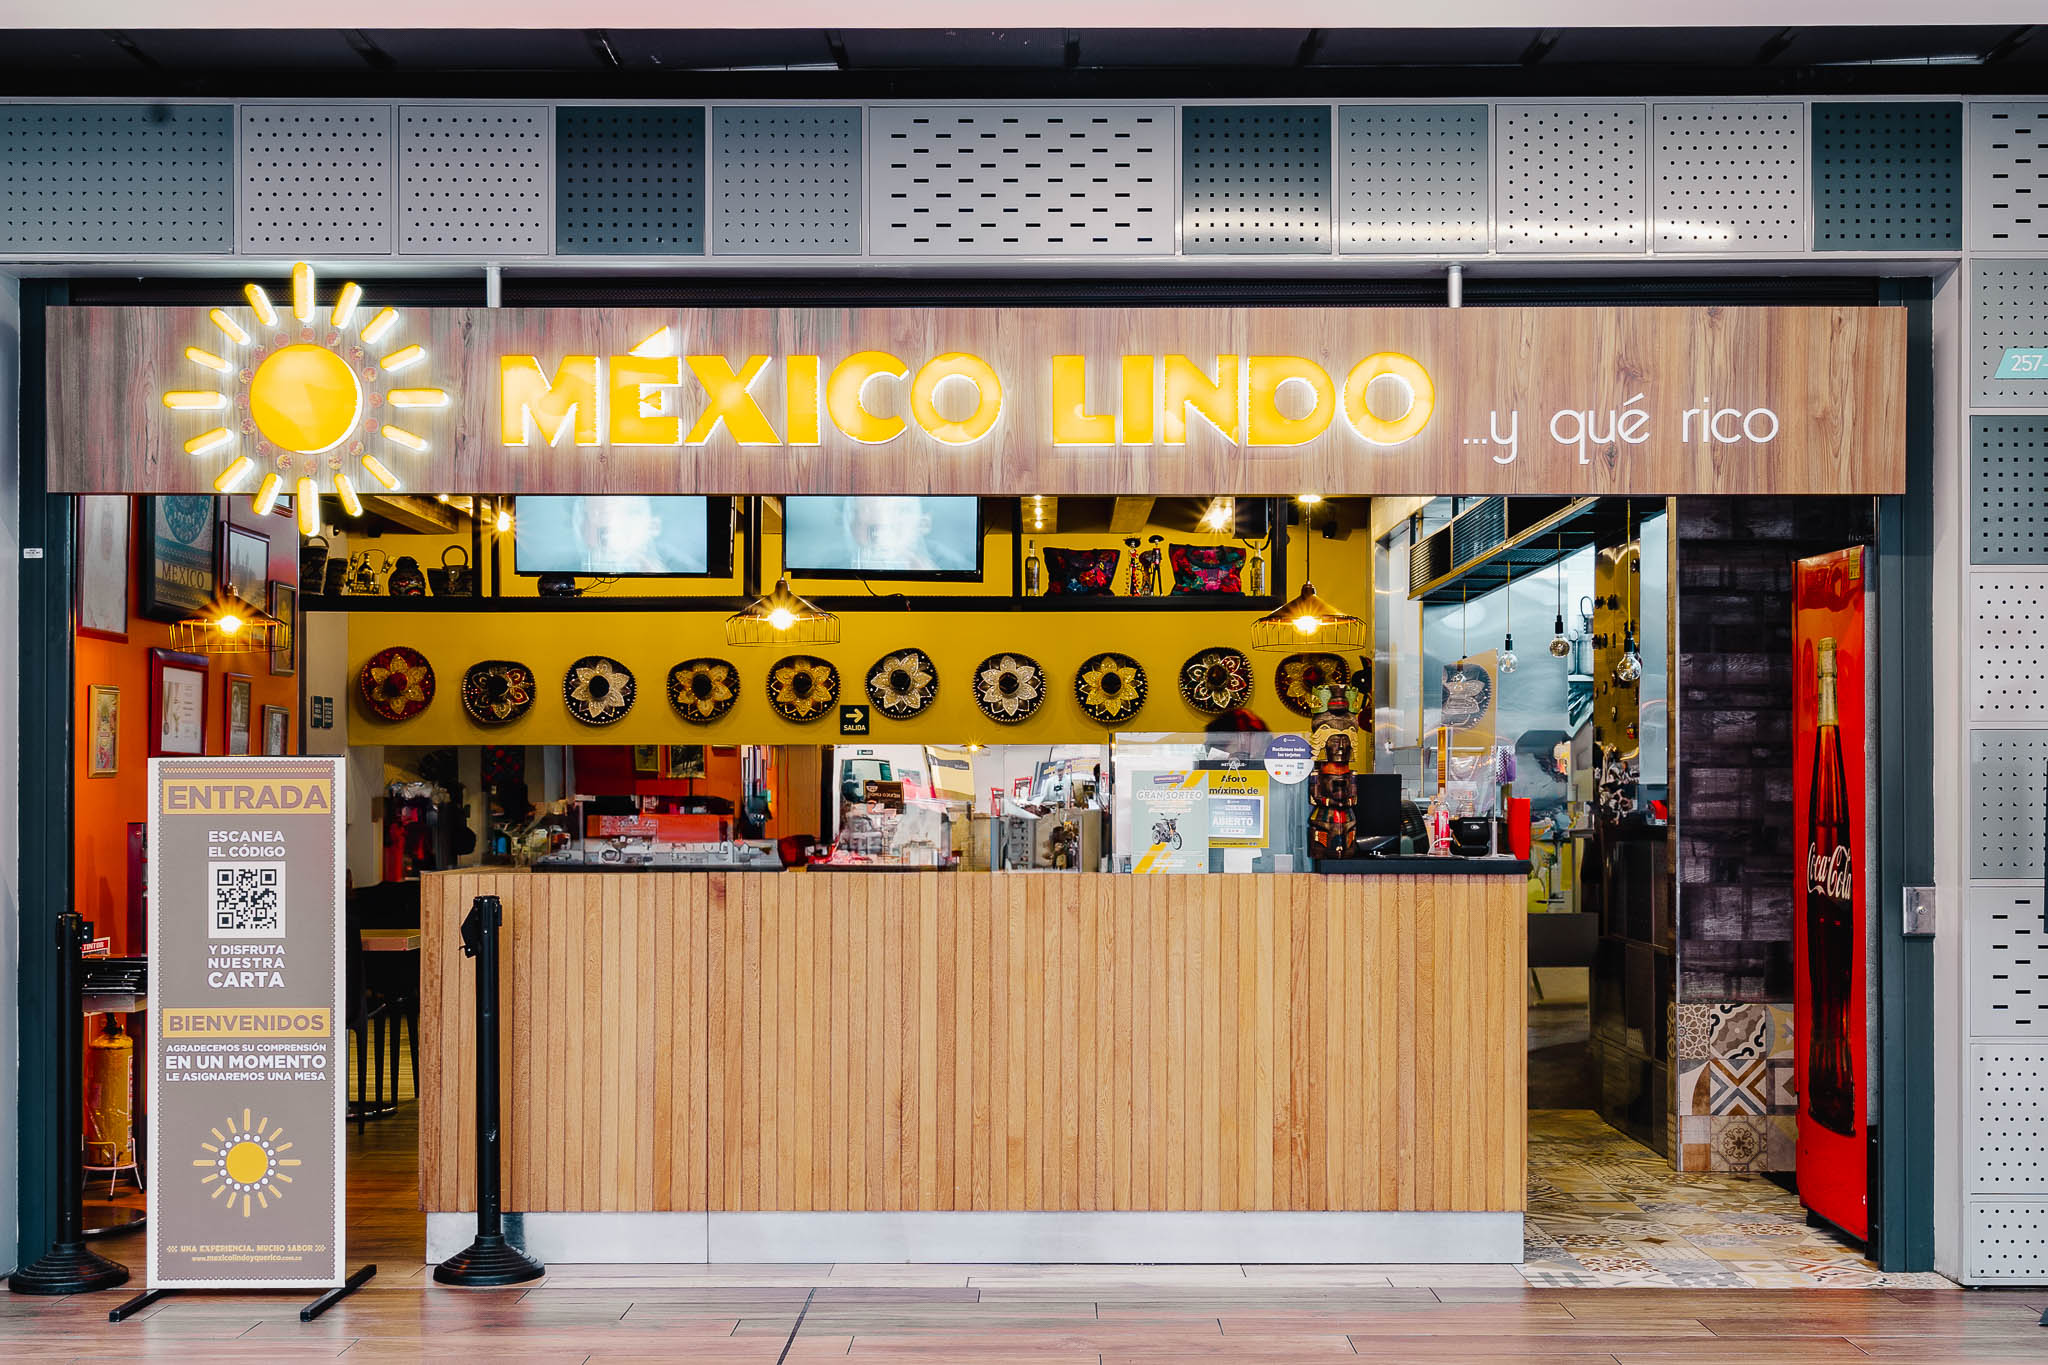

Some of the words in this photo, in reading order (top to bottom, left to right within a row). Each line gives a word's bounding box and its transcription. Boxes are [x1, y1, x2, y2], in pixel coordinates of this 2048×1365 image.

[501, 326, 1003, 447] MÉXICO
[1052, 351, 1436, 447] LINDO
[1550, 392, 1650, 464] qué
[1682, 396, 1779, 443] rico
[1220, 774, 1248, 783] Aforo
[1136, 791, 1163, 800] GRAN
[1165, 791, 1203, 800] SORTEO
[1208, 786, 1245, 795] máximo
[1247, 787, 1259, 795] de
[168, 785, 328, 809] ENTRADA
[208, 831, 285, 843] ESCANEA
[208, 846, 226, 857] EL
[229, 844, 286, 858] CÓDIGO
[1807, 842, 1852, 900] Coca-Cola
[208, 945, 218, 955] Y
[221, 945, 285, 955] DISFRUTA
[208, 957, 285, 969] NUESTRA
[208, 971, 285, 988] CARTA
[169, 1015, 324, 1031] BIENVENIDOS
[166, 1044, 240, 1053] AGRADECEMOS
[242, 1044, 255, 1052] SU
[257, 1042, 327, 1052] COMPRENSIÓN
[165, 1055, 191, 1069] EN
[197, 1055, 224, 1069] UN
[229, 1054, 327, 1069] MOMENTO
[166, 1072, 180, 1081] LE
[182, 1072, 265, 1081] ASIGNAREMOS
[267, 1072, 292, 1081] UNA
[294, 1072, 326, 1081] MESA
[256, 1244, 286, 1252] MUCHO
[287, 1244, 313, 1252] SABOR
